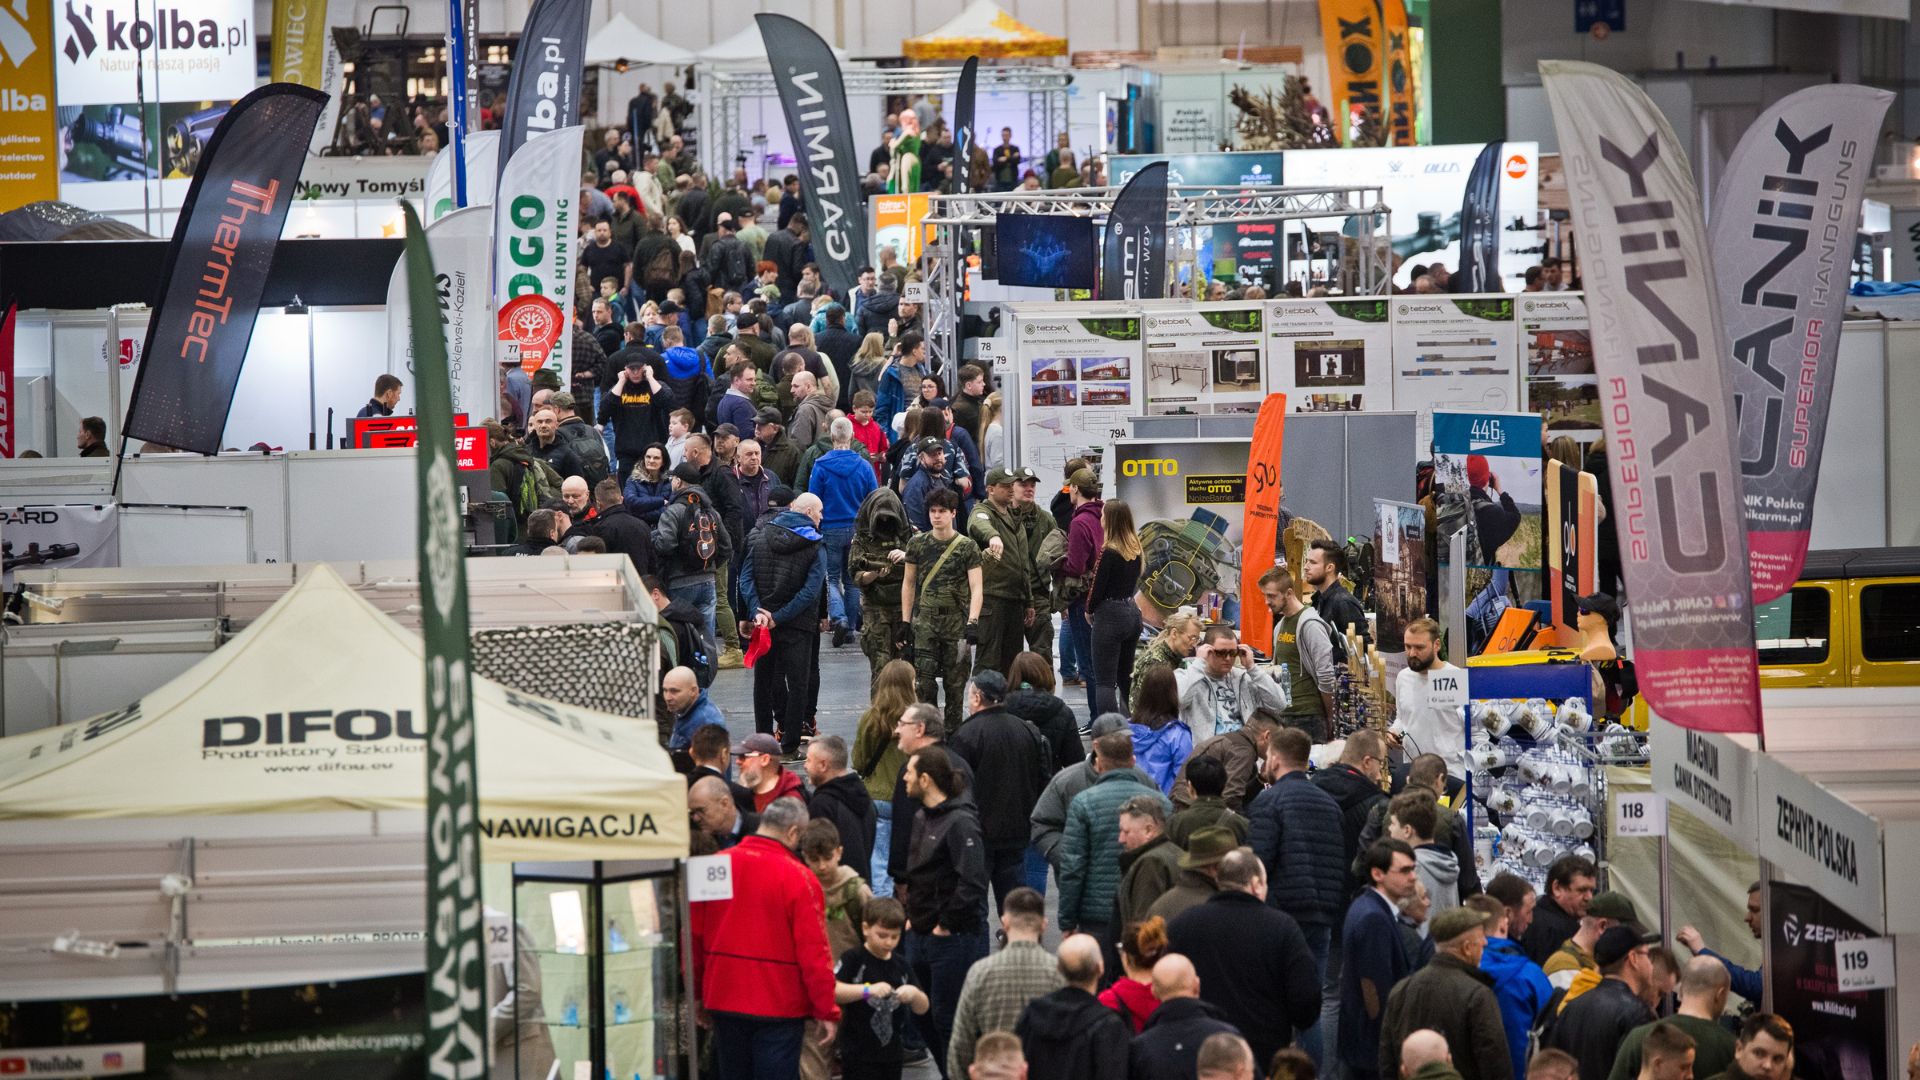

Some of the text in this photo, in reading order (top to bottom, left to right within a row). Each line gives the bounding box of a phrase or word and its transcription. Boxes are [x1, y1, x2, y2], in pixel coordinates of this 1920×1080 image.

[106, 9, 248, 55] kolba.pl
[297, 177, 425, 197] Nowy Tomyśl
[554, 198, 569, 280] HUNTING
[907, 287, 921, 295] 57A
[1789, 139, 1858, 469] SUPERIOR HANDGUNS
[508, 344, 518, 353] 77
[981, 342, 992, 351] 78
[995, 356, 1007, 365] 79
[1109, 429, 1127, 438] 79A
[1470, 419, 1500, 440] 446
[1122, 458, 1179, 477] OTTO
[1207, 485, 1232, 493] OTTO
[1766, 496, 1805, 510] Polska
[1432, 678, 1458, 691] 117A
[202, 746, 337, 760] Protraktory
[1686, 728, 1719, 782] MAGNUM
[264, 761, 394, 773] www.difou.eu
[1674, 762, 1693, 799] CANIK
[1622, 802, 1644, 818] 118
[478, 813, 659, 839] NAWIGACJA
[1776, 794, 1859, 887] ZEPHYR POLSKA
[706, 865, 728, 881] 89
[1842, 950, 1869, 971] 119
[28, 1056, 85, 1073] YouTube
